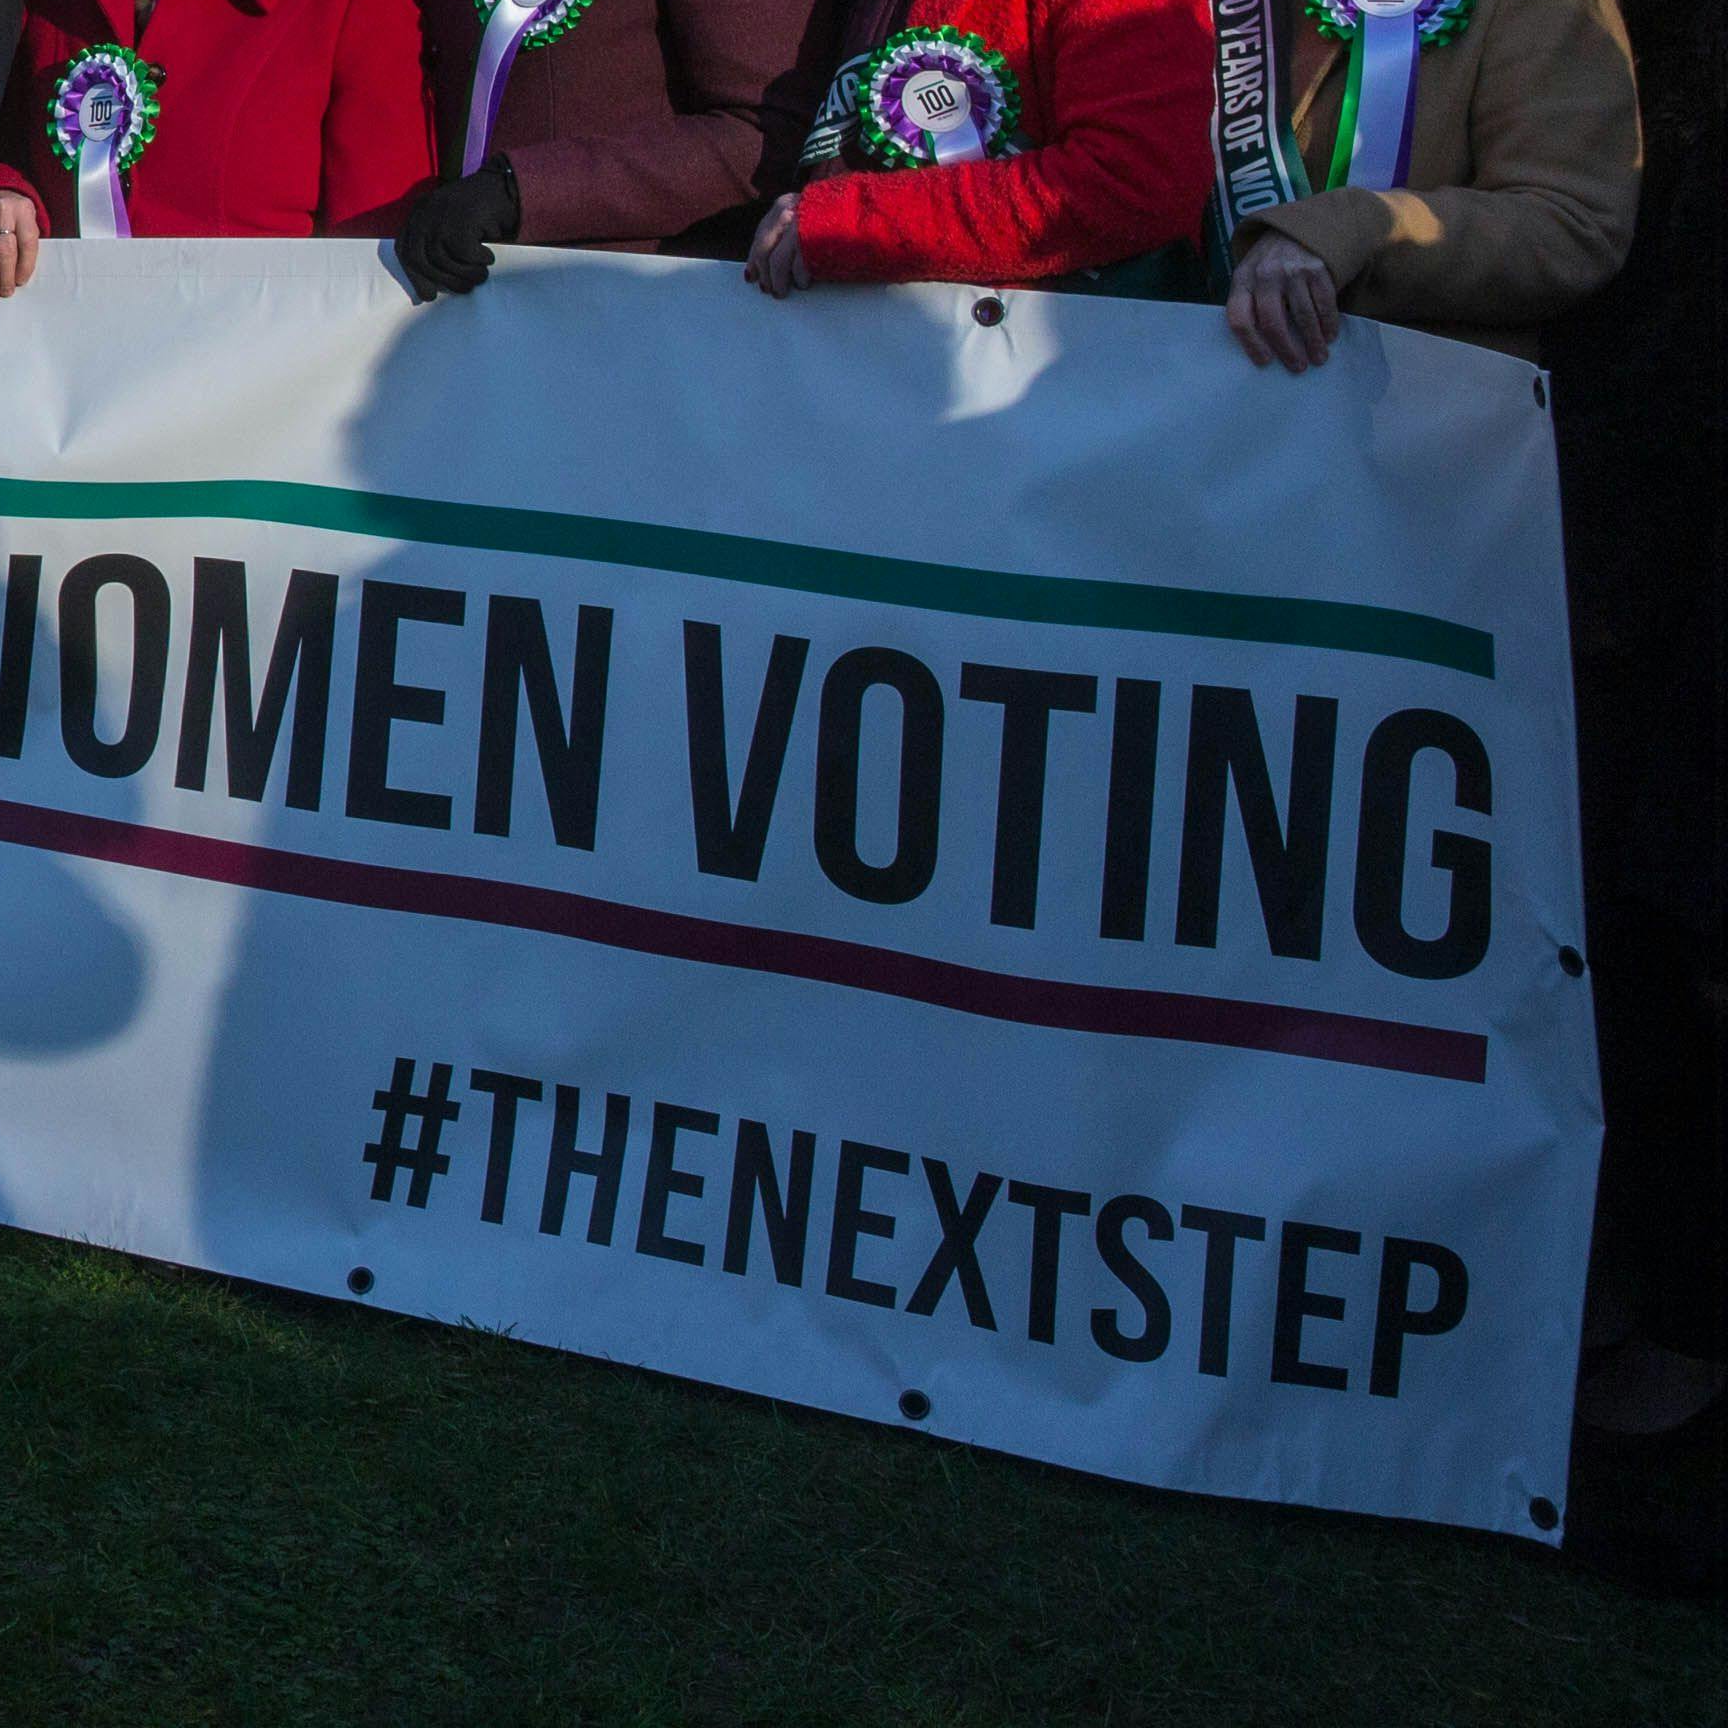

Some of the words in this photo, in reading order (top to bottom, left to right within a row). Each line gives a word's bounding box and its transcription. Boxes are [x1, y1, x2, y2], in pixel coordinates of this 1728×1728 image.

[1220, 13, 1264, 115] YEARS
[89, 99, 112, 122] 100
[917, 84, 955, 115] 100
[1223, 114, 1265, 153] OF
[682, 617, 1495, 981] VOTING
[362, 1055, 1470, 1400] #THENEXTSTEP
